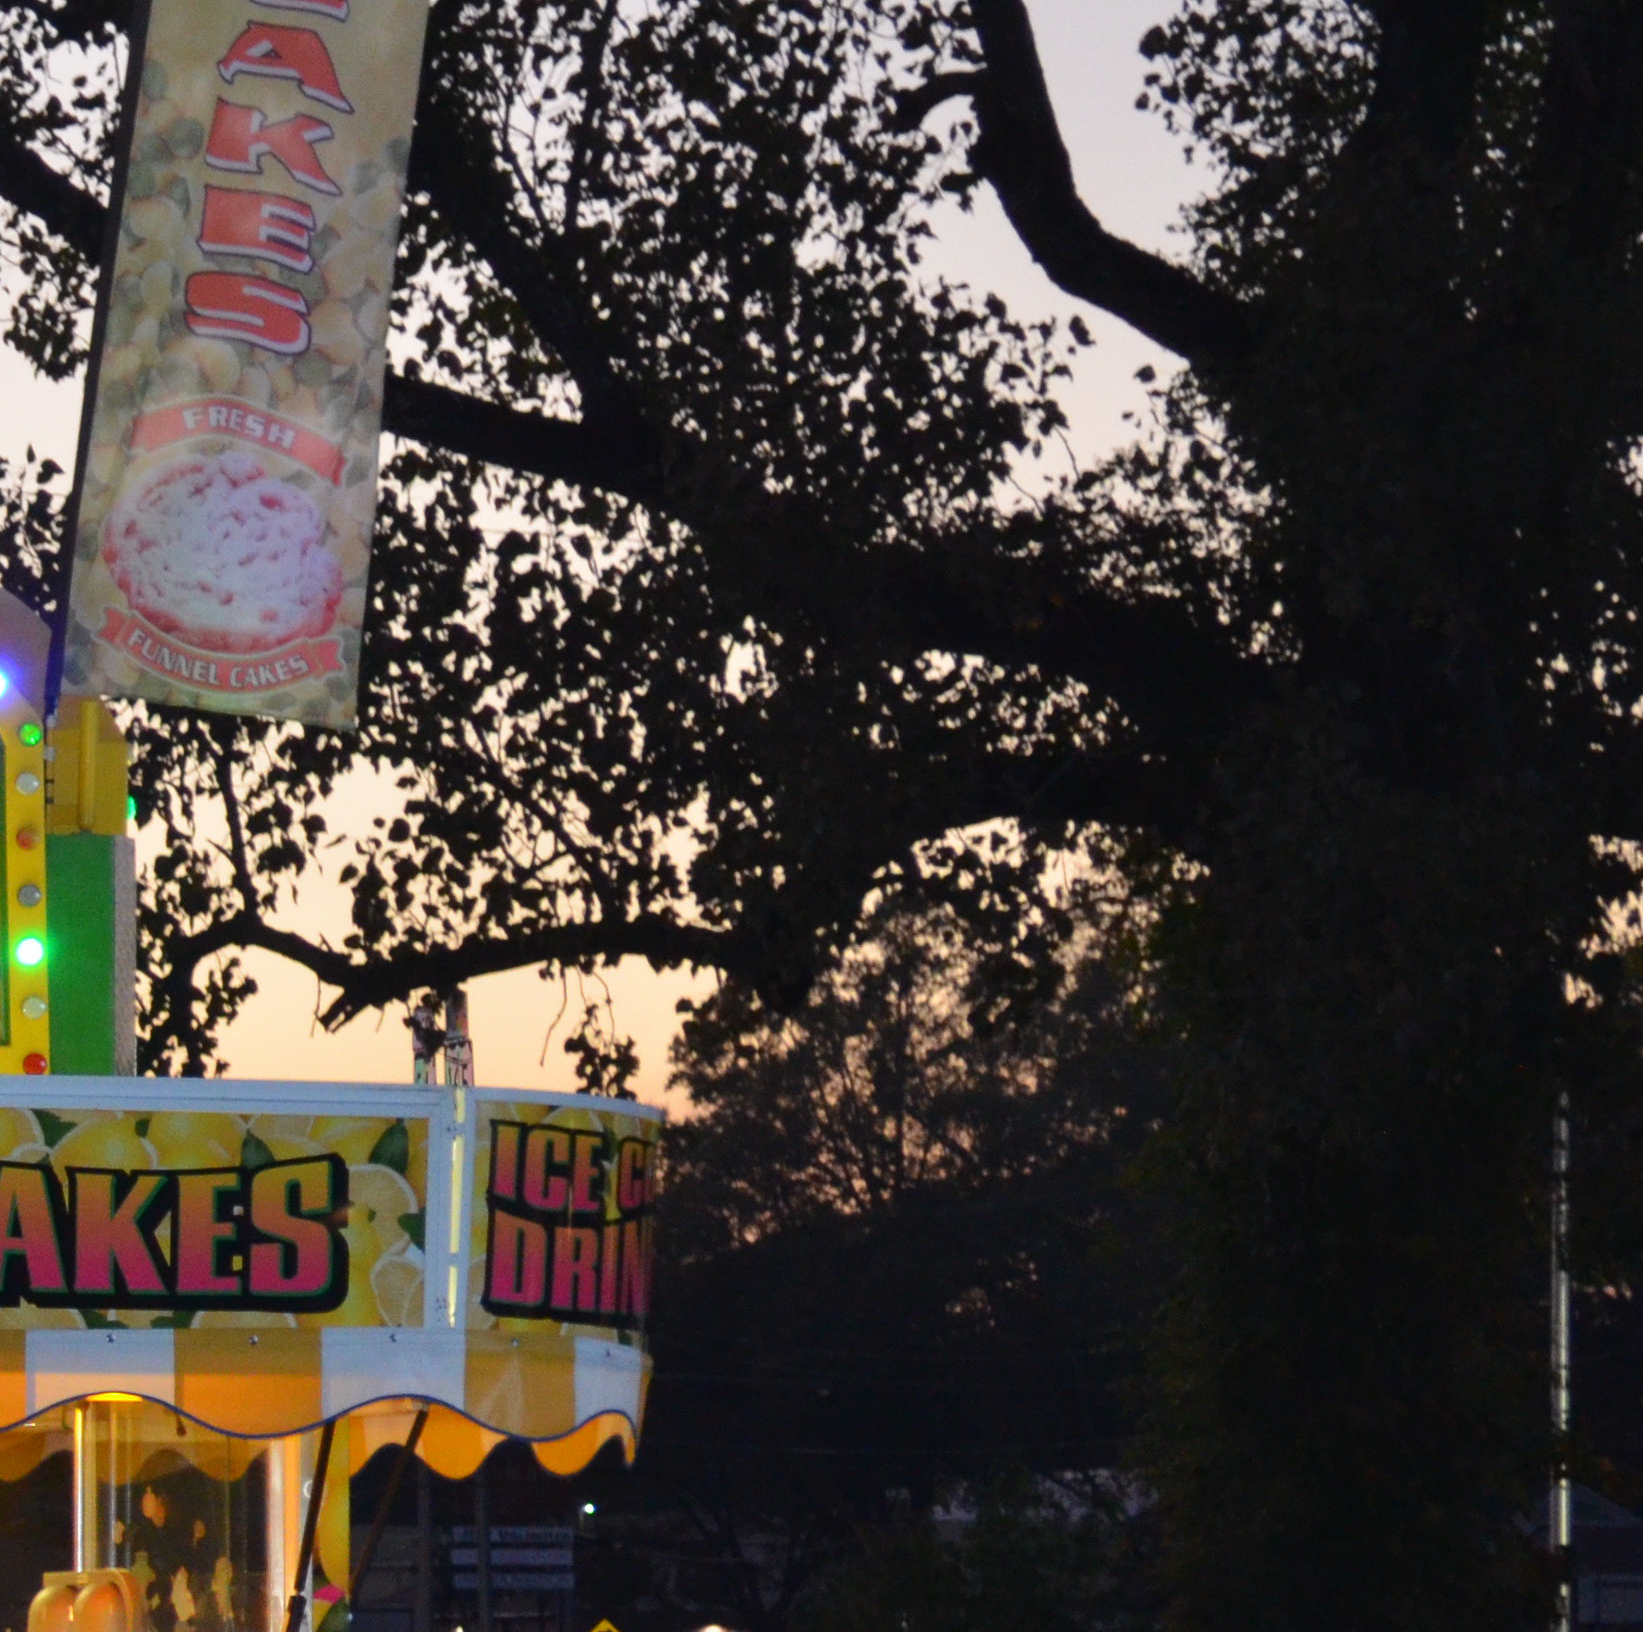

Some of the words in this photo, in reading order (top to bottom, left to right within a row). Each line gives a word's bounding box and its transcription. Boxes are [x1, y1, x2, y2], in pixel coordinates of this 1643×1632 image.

[185, 0, 355, 355] AKES
[182, 405, 297, 449] FRESH
[127, 627, 221, 686] FUNNEL
[228, 654, 310, 689] CAKES
[488, 1118, 610, 1213] ICE
